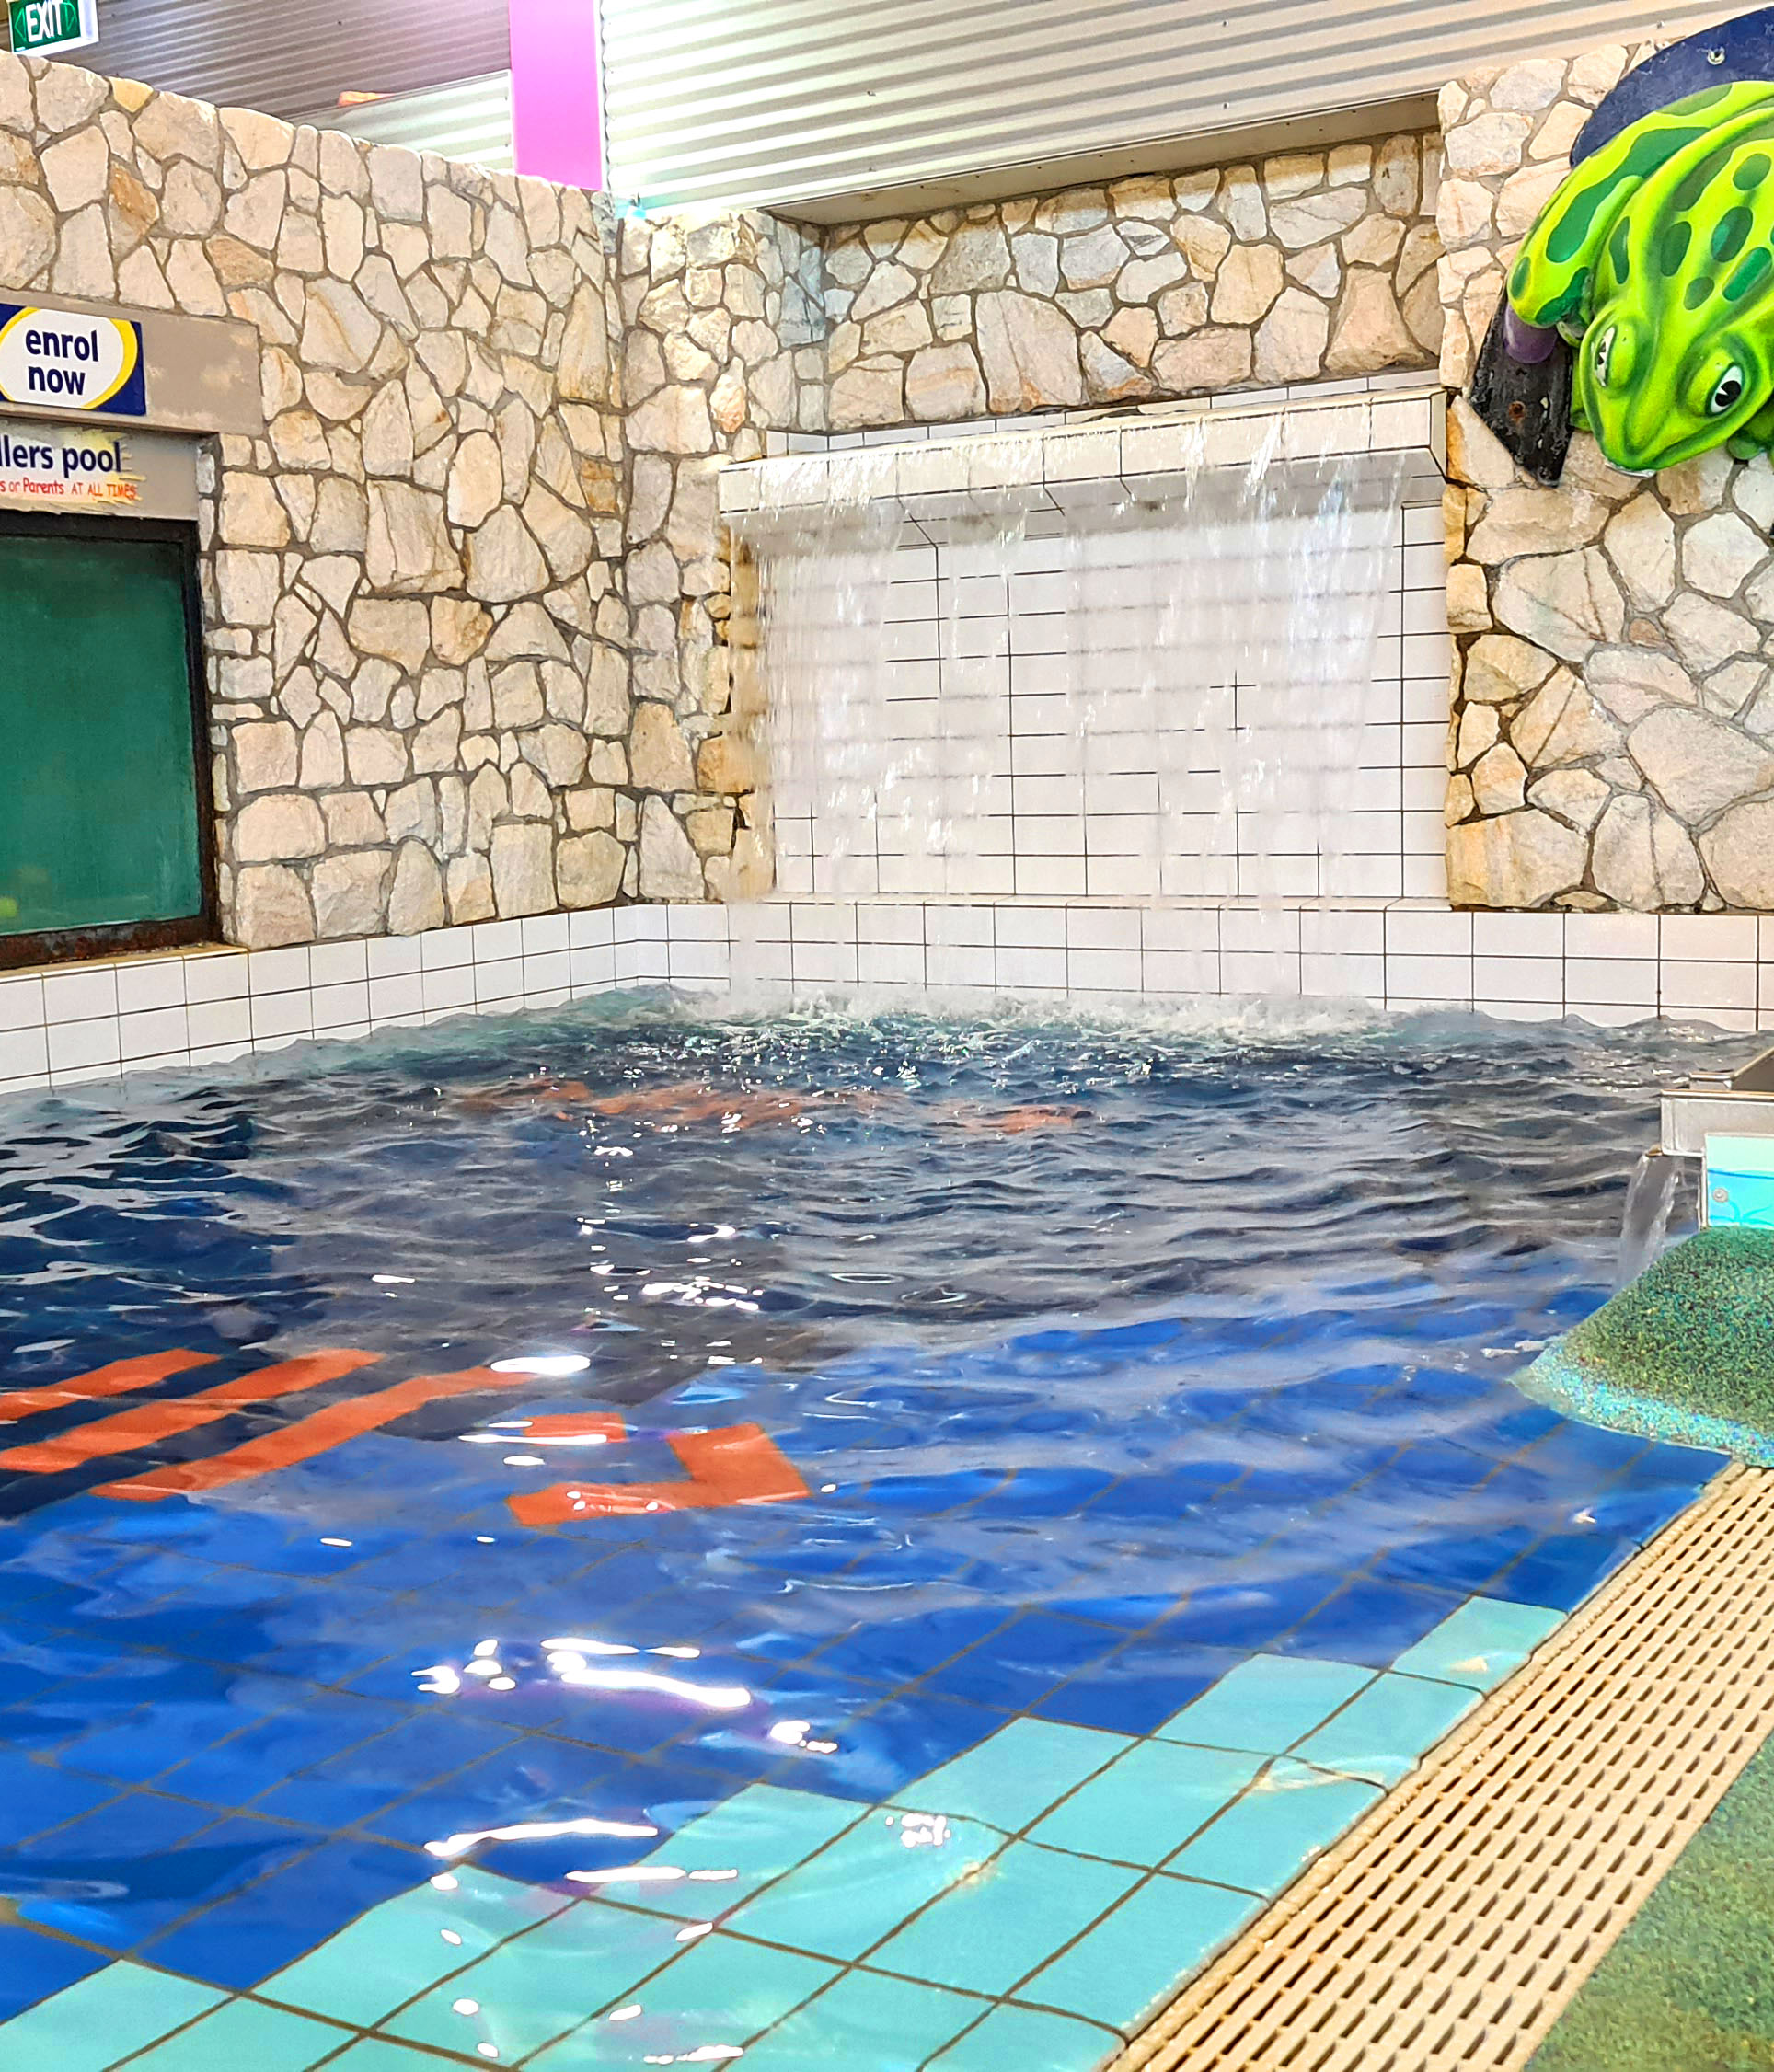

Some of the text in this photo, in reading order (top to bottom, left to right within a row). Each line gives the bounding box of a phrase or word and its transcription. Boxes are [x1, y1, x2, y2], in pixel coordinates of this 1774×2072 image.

[25, 0, 63, 42] EXIT
[26, 329, 98, 362] enrol
[29, 366, 86, 396] now
[62, 441, 121, 478] pool
[9, 481, 20, 493] or
[22, 477, 64, 495] Parents
[71, 482, 83, 494] AT
[87, 483, 103, 497] ALL
[106, 483, 136, 500] TIMES
